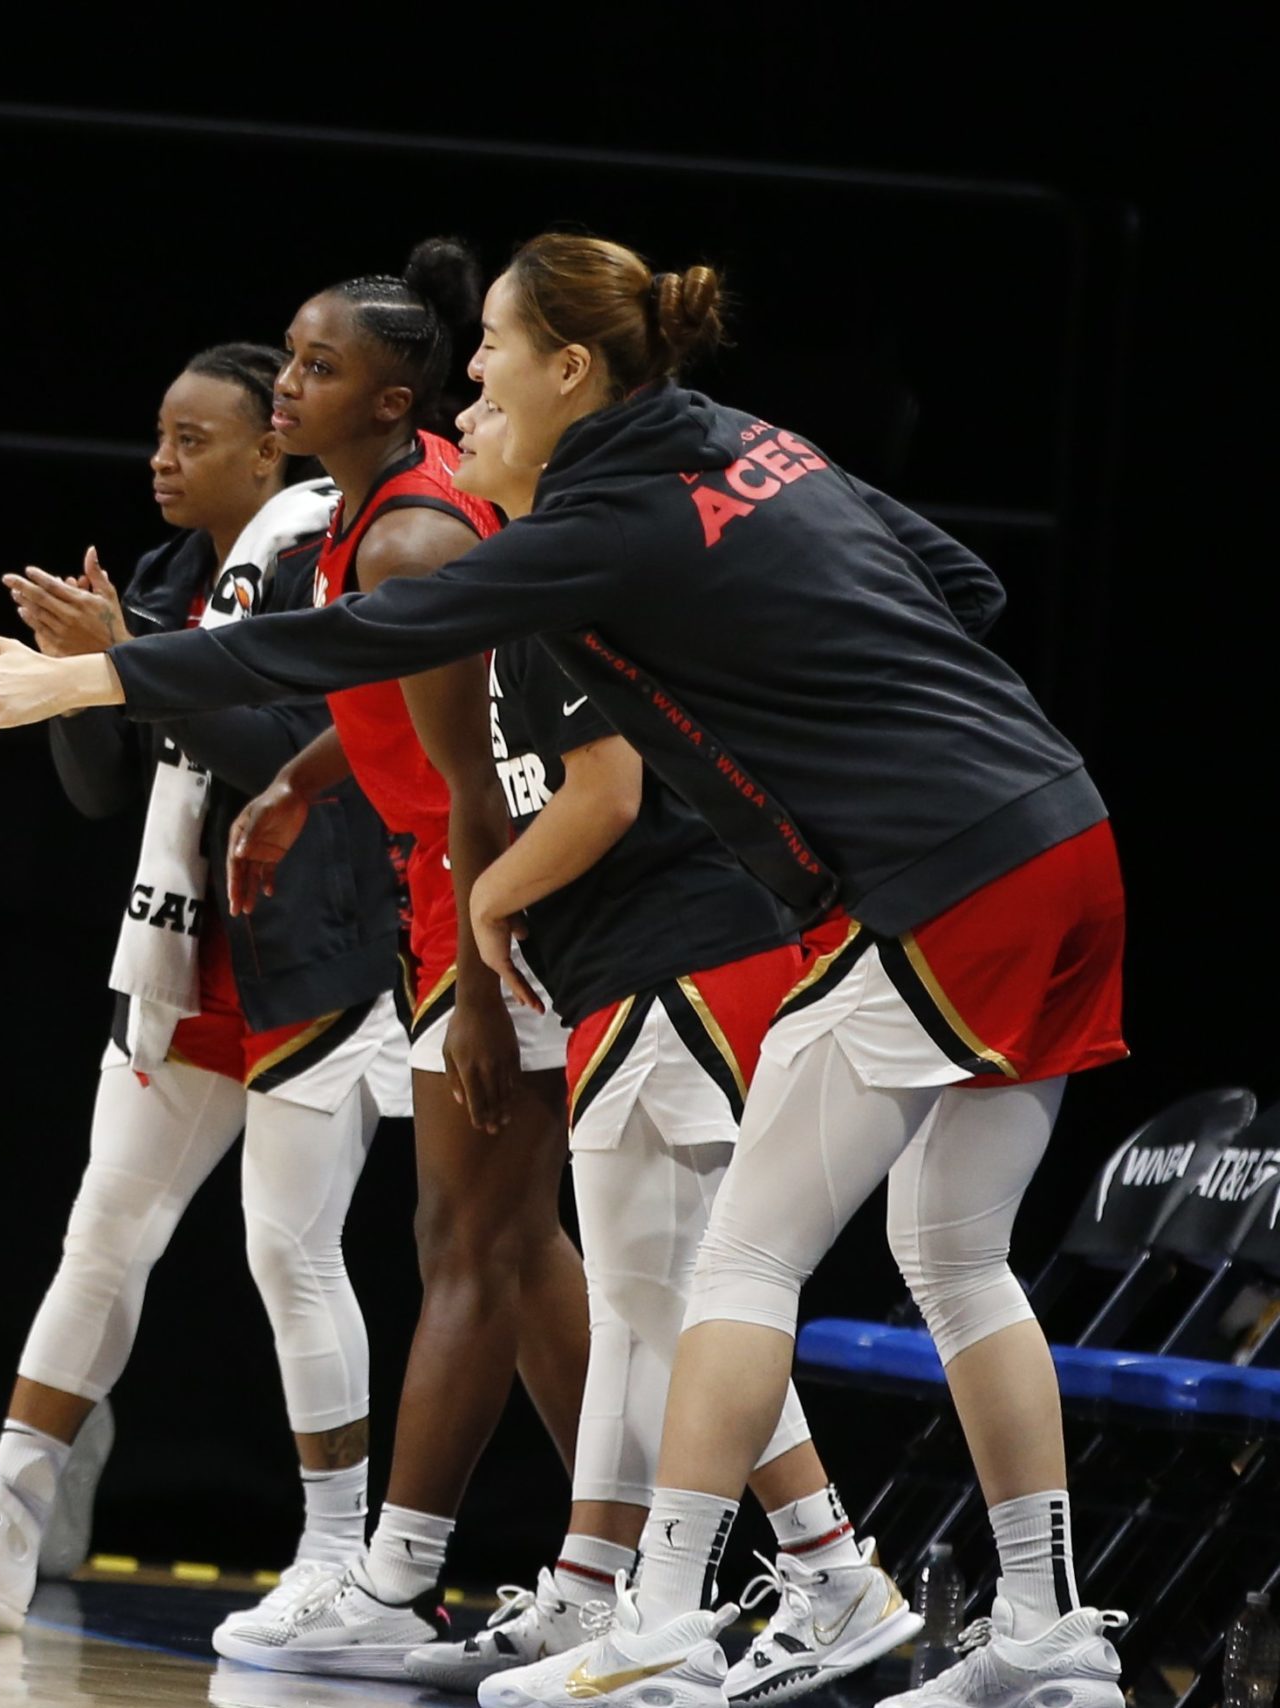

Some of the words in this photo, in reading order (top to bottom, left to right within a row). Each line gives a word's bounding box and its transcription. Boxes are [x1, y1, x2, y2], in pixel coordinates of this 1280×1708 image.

[690, 430, 829, 549] ACES
[652, 691, 704, 746] WNBA
[716, 754, 767, 809] WNBA
[778, 821, 821, 875] WNBA
